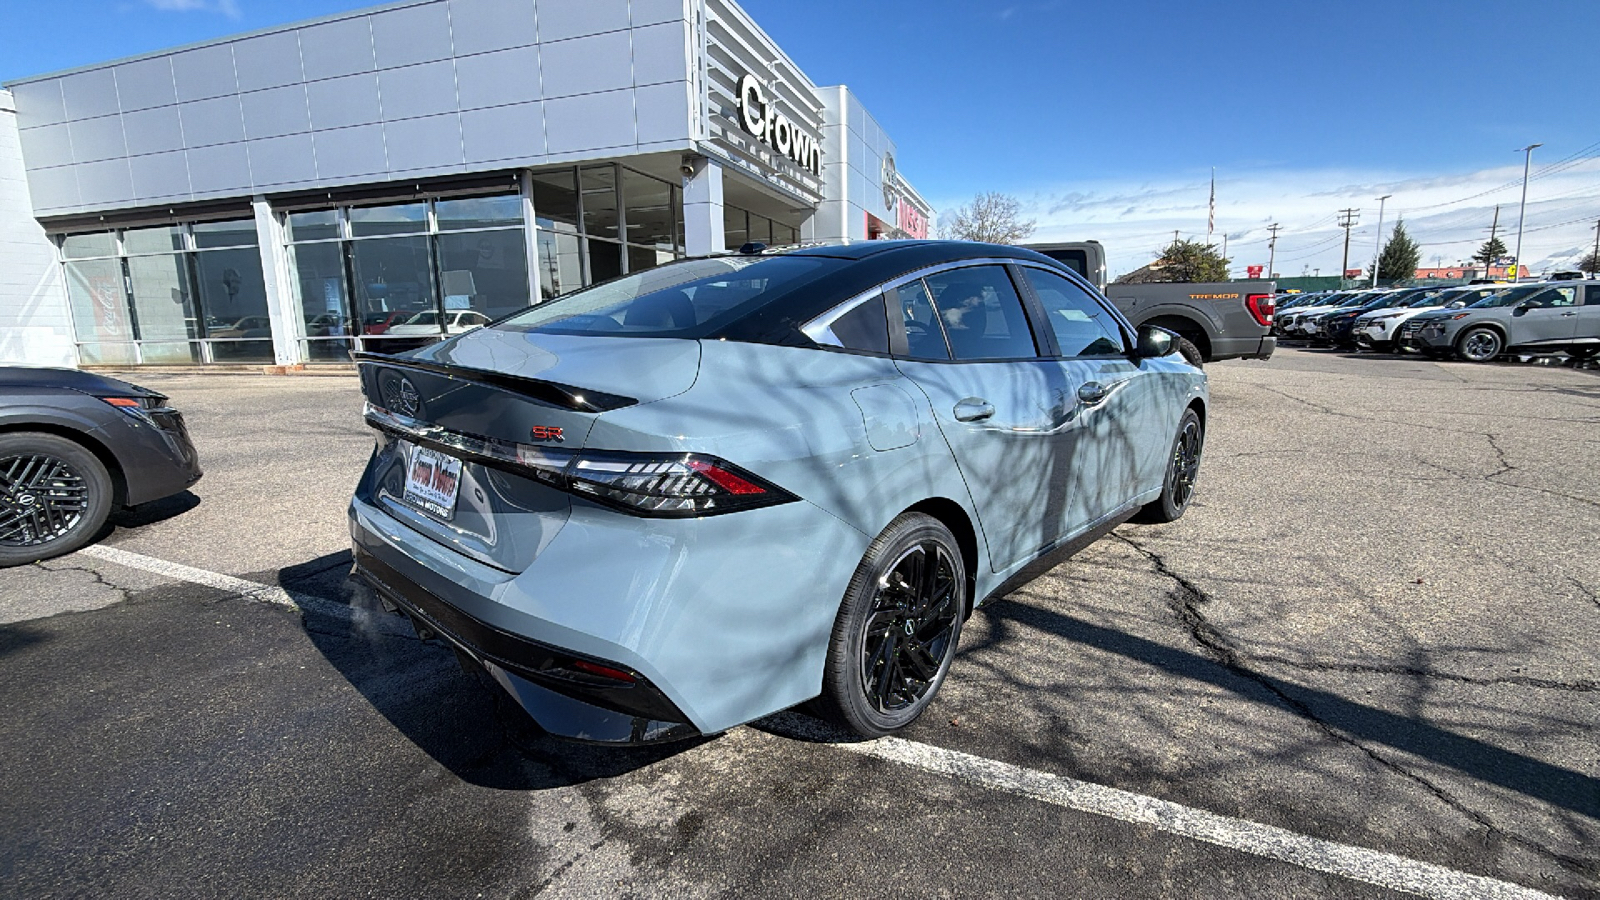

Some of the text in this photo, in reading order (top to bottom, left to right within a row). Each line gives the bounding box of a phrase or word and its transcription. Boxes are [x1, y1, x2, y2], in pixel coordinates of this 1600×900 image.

[738, 74, 821, 176] Crown
[532, 425, 565, 440] SR
[425, 500, 449, 518] MOTORS
